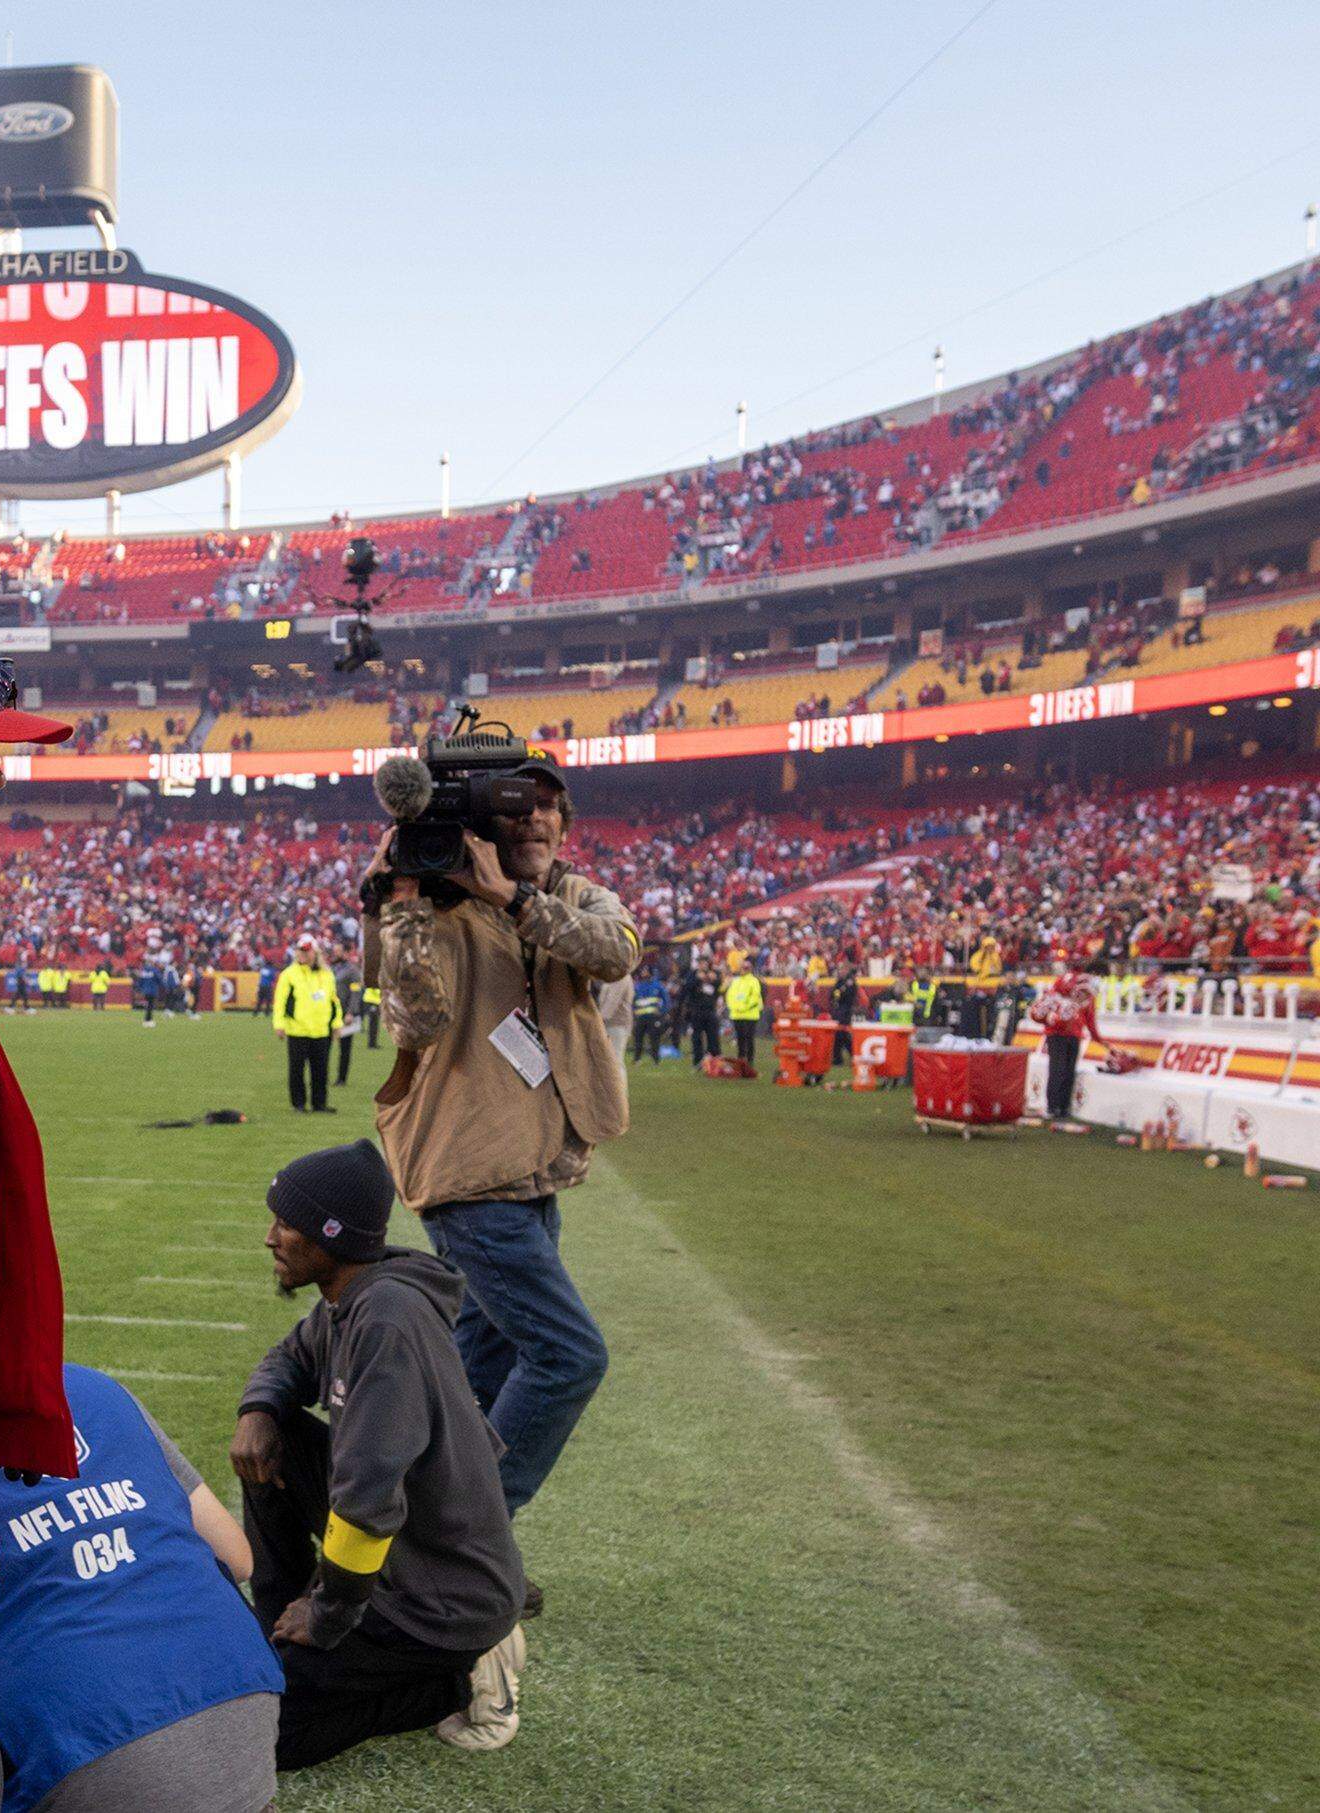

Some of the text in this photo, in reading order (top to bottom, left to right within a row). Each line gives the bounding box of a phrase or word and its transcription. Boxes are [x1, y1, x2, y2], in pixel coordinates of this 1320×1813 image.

[48, 250, 129, 276] FIELD
[100, 336, 240, 447] WIN
[861, 1035, 888, 1064] G
[1164, 1041, 1229, 1077] CHIEFS
[8, 1479, 147, 1553] NFL FILMS
[72, 1527, 137, 1580] 034
